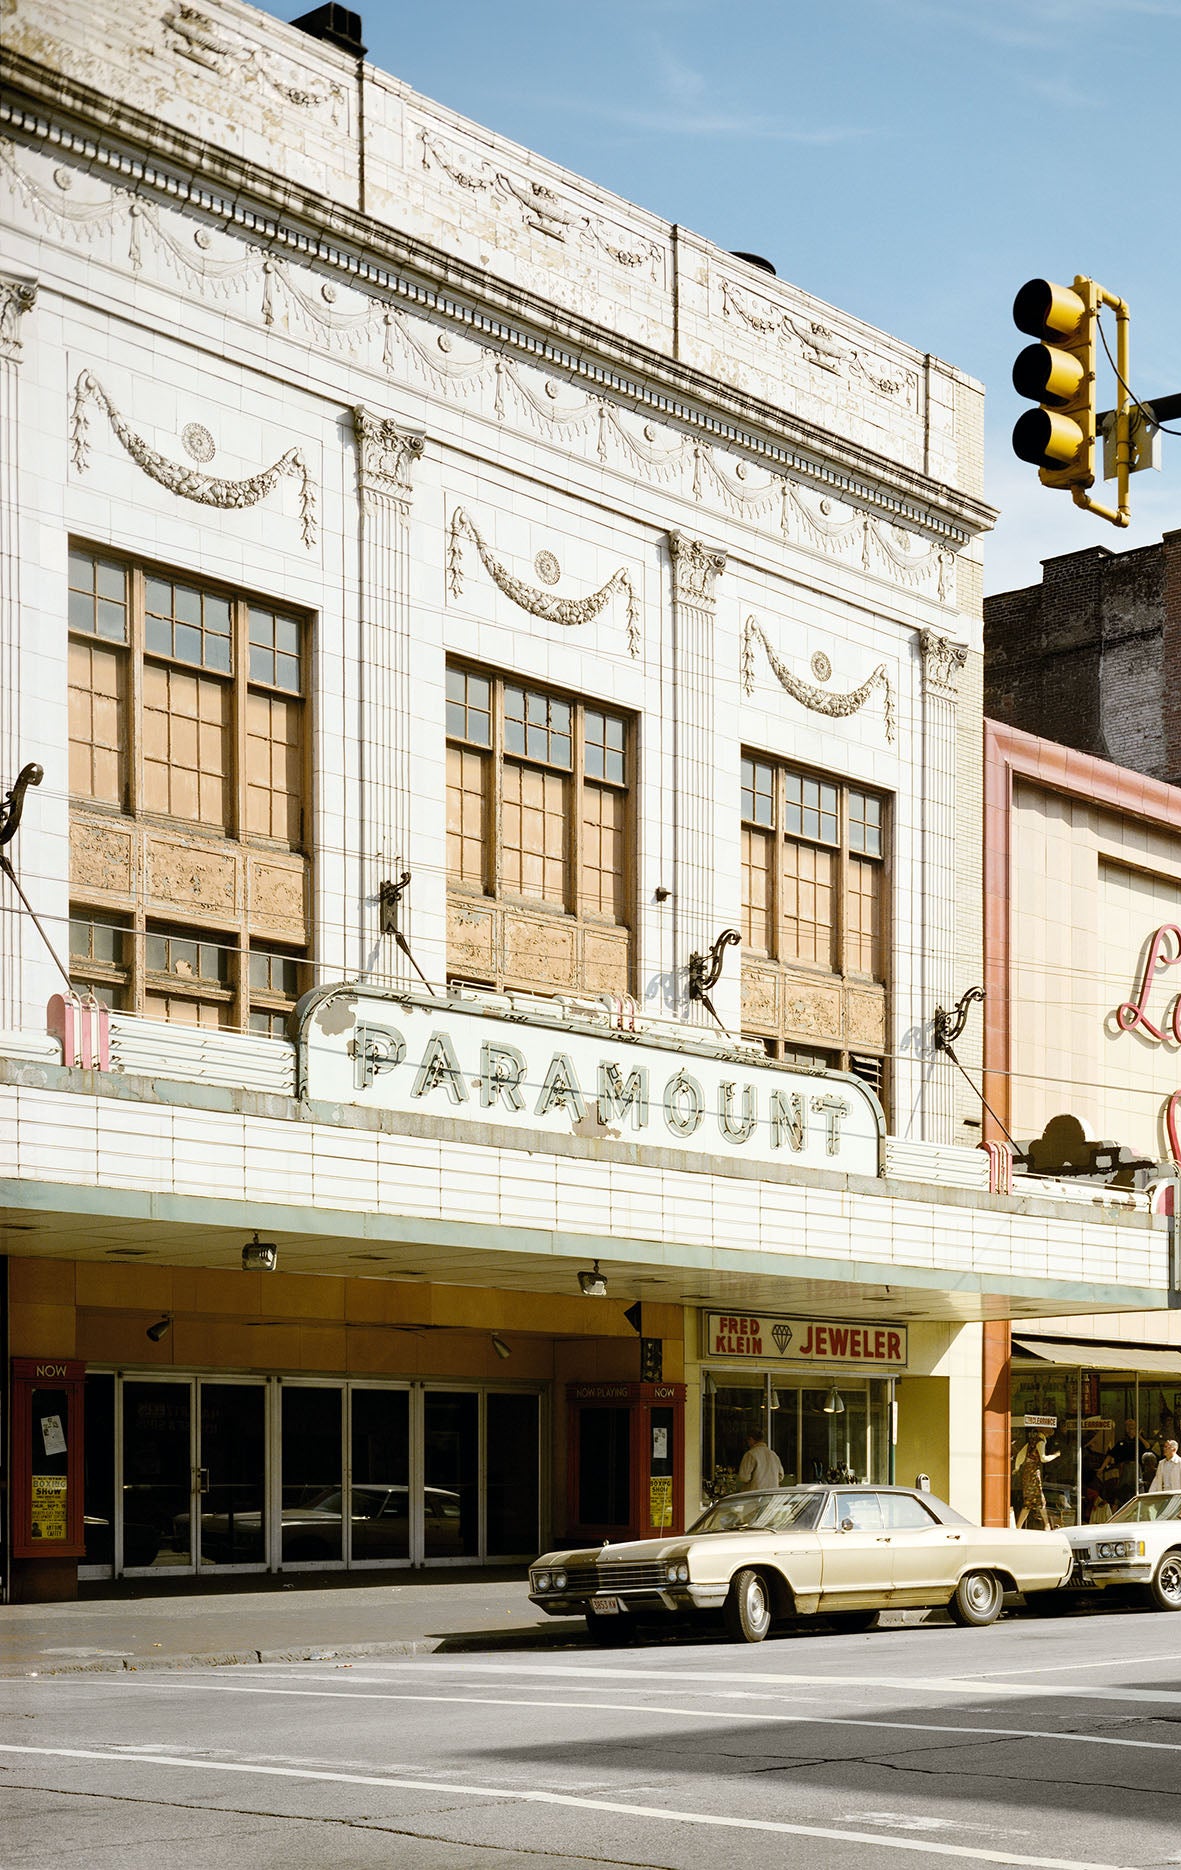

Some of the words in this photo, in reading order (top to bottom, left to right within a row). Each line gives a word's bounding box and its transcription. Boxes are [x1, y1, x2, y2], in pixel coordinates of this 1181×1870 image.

[350, 1018, 854, 1157] PARAMOUNT
[719, 1317, 760, 1336] FRED
[715, 1334, 763, 1355] KLEIN
[800, 1325, 901, 1360] JEWELER
[36, 1365, 67, 1377] NOW
[654, 1387, 675, 1398] NOW
[33, 1480, 66, 1488] BOXING
[36, 1487, 62, 1495] SHOW
